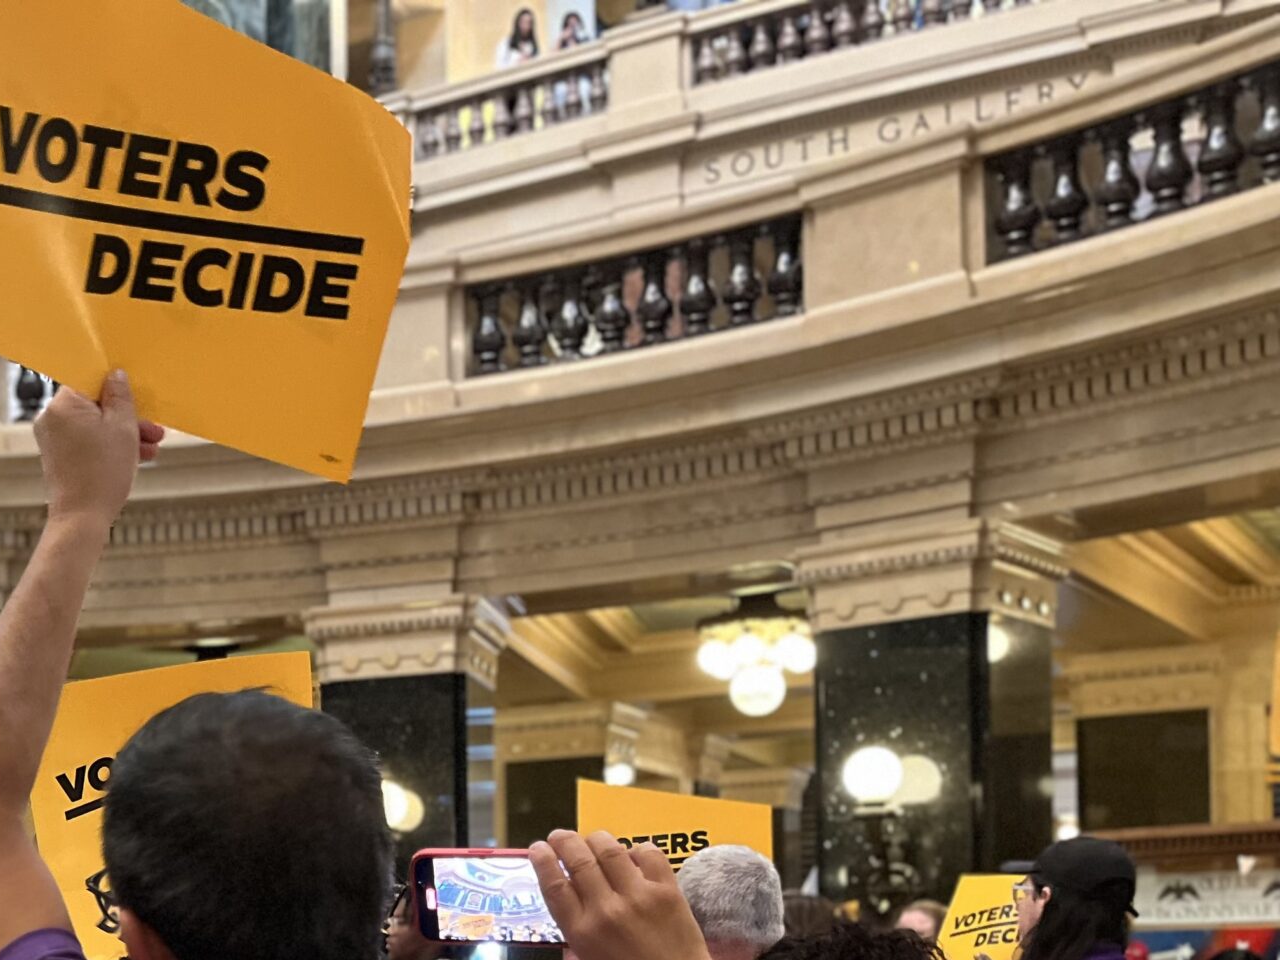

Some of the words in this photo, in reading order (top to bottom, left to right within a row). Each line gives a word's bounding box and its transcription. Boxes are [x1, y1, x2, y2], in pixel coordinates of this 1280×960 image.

[704, 128, 851, 185] SOUTH
[84, 233, 359, 321] DECIDE
[954, 904, 1019, 930] VOTER
